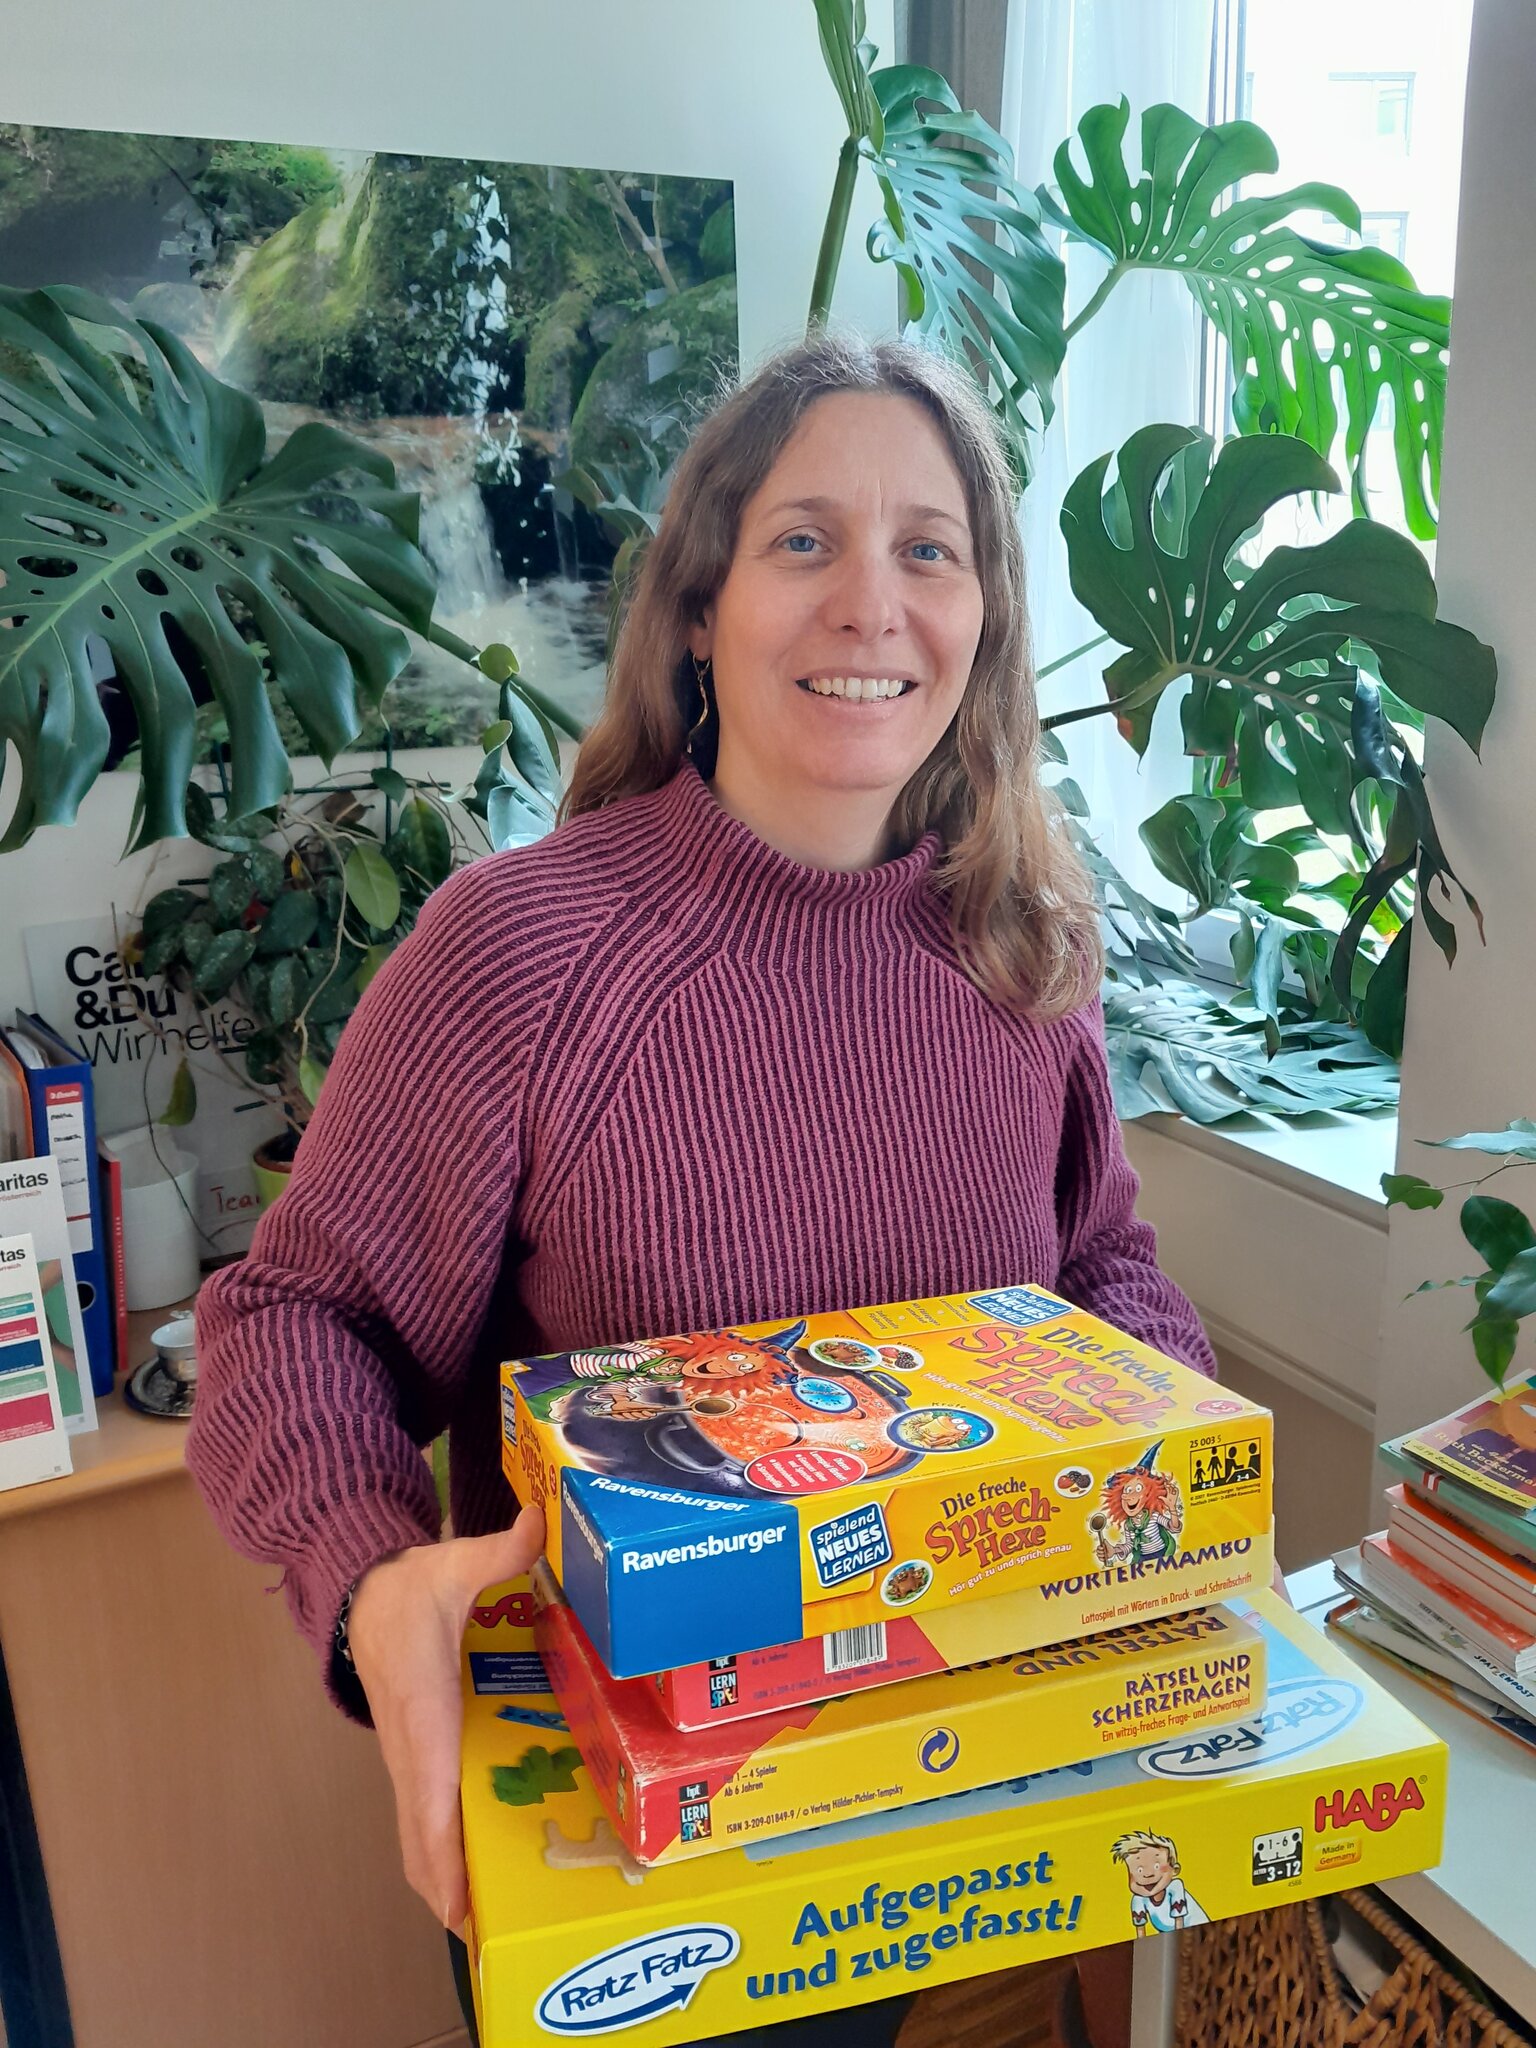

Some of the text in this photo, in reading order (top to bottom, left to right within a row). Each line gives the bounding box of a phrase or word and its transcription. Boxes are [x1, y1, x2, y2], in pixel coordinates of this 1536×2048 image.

[78, 1027, 150, 1067] Wir
[209, 1186, 261, 1214] Tea
[974, 1298, 1035, 1324] LERNEN
[990, 1293, 1053, 1319] NEUES
[947, 1327, 1178, 1429] Sprech-
[1038, 1327, 1177, 1393] Die freche
[967, 1368, 1103, 1430] Hexe
[1189, 1439, 1198, 1449] 25
[1200, 1436, 1215, 1447] 003
[1434, 1432, 1466, 1452] Ruth
[589, 1477, 750, 1514] Ravensburger
[940, 1477, 1027, 1519] Die freche
[817, 1507, 875, 1544] spielend
[818, 1524, 883, 1564] NEUES
[925, 1487, 1061, 1564] Sprech-
[622, 1525, 787, 1574] Ravensburger
[823, 1542, 885, 1581] LERNEN
[974, 1524, 1046, 1569] Hexe
[949, 1544, 1072, 1597] Hör gut zu und sprich genau
[1081, 1608, 1116, 1625] Lottospiel
[1117, 1603, 1129, 1616] mit
[1161, 1596, 1168, 1605] in
[1194, 1585, 1207, 1598] und
[710, 1672, 737, 1691] LERN
[1013, 1650, 1101, 1676] UND
[1126, 1654, 1251, 1699] RÄTSEL UND
[1473, 1654, 1535, 1699] SPATZENPOST
[1092, 1673, 1251, 1728] SCHERZFRAGEN
[1102, 1693, 1251, 1742] Ein witzig-freches Frage- und Antwortspiel
[1180, 1726, 1267, 1765] Fatz
[724, 1781, 764, 1798] Ab 6 Jahren
[755, 1765, 778, 1777] Spieler
[681, 1803, 708, 1823] LERN
[726, 1822, 743, 1834] ISBN
[744, 1809, 795, 1830] 3-209-01849-9
[810, 1802, 832, 1814] Verlag
[1314, 1777, 1425, 1833] HABA
[1320, 1851, 1357, 1866] Germany
[1322, 1841, 1355, 1855] Made in
[791, 1851, 1054, 1945] Aufgepasst
[747, 1895, 1083, 2000] und zugefasst!
[560, 1943, 714, 2018] Ratz Fatz
